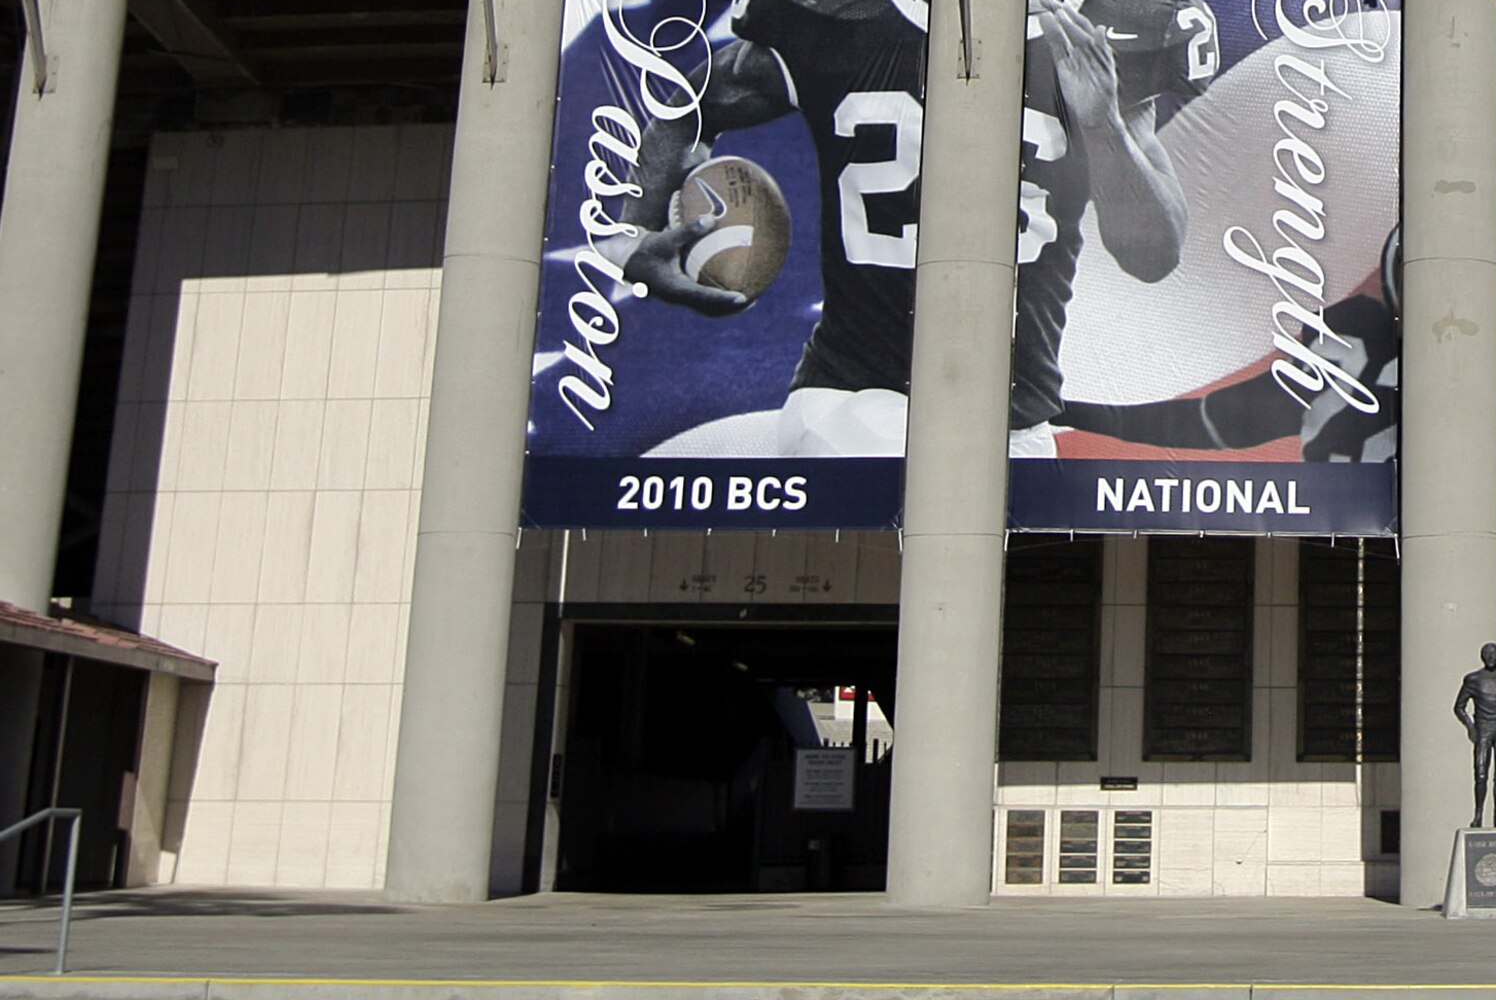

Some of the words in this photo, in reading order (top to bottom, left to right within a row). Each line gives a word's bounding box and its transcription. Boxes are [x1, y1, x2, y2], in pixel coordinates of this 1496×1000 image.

[834, 91, 925, 270] 2
[616, 475, 714, 511] 2010
[726, 475, 809, 511] BCS
[1095, 476, 1311, 516] NATIONAL
[743, 575, 768, 595] 25
